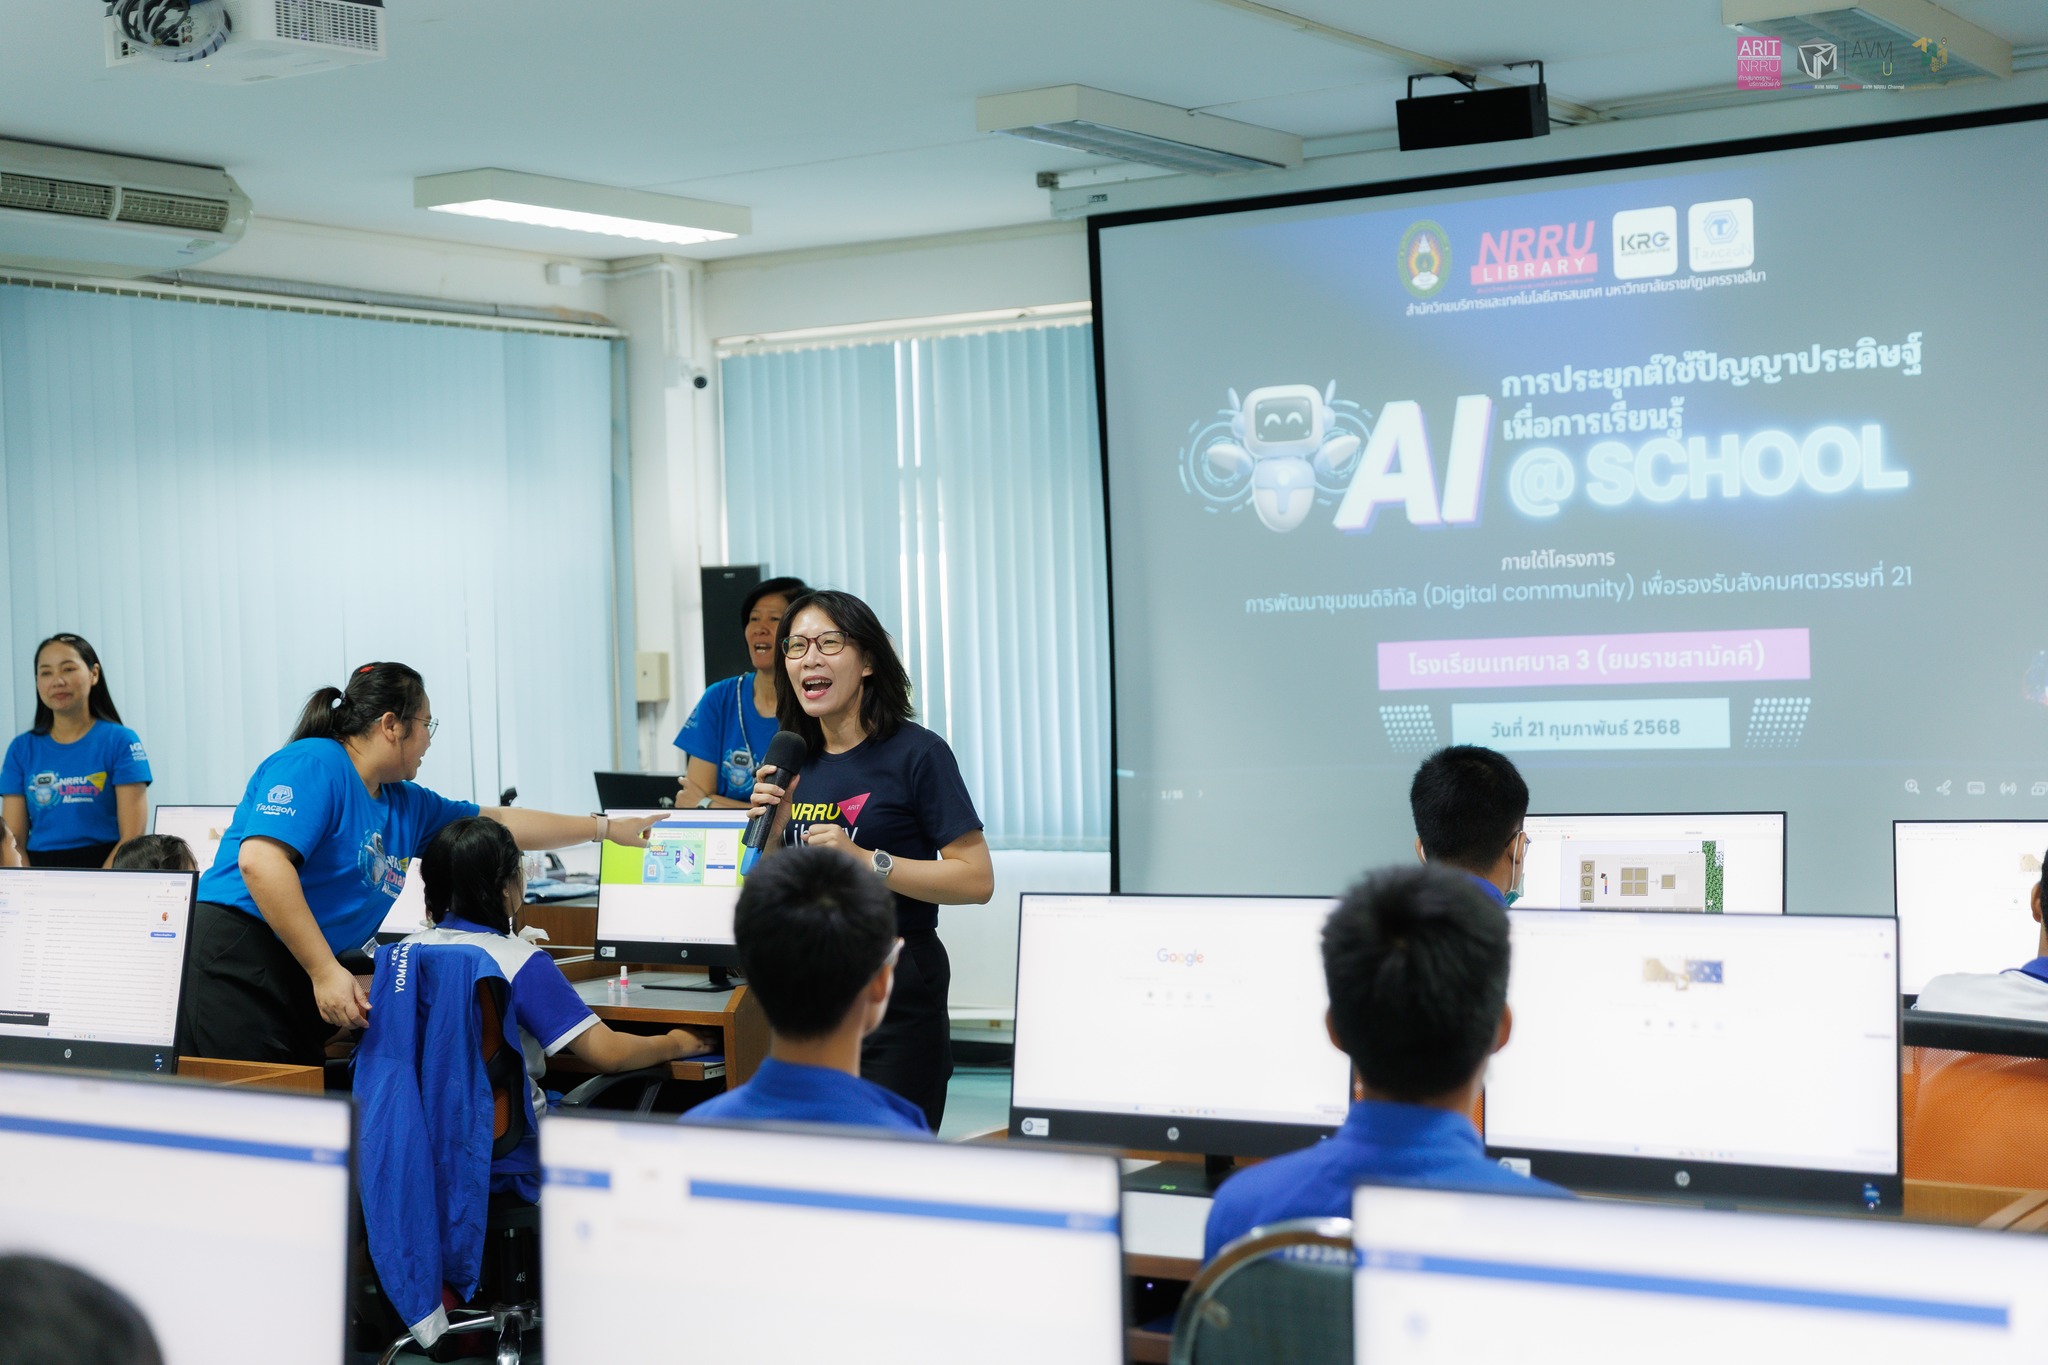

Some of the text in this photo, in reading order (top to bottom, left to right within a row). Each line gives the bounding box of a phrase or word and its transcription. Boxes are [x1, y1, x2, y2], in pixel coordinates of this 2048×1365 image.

[1477, 219, 1596, 267] NRRU
[1482, 257, 1586, 282] LIBRARY
[1501, 331, 1923, 399] การประยุกต์ใช้ปัญญาประดิษฐ์
[1502, 396, 1685, 441] เพื่อการเรียนรู้
[1333, 394, 1492, 531] AI
[1501, 549, 1616, 571] ภายใต้โครงการ
[1245, 560, 1913, 615] การพัฒนาชุมชนดิจิทัล (Digital community) เพื่อรองรับสังคมศตวรรษที่ 21
[1409, 638, 1766, 678] โรงเรียนเทศบาล 3 (ยมราชสามัคคี)
[1490, 717, 1681, 742] วันที่ 21 กุมภาพันธ์ 2568
[1157, 947, 1204, 967] Google
